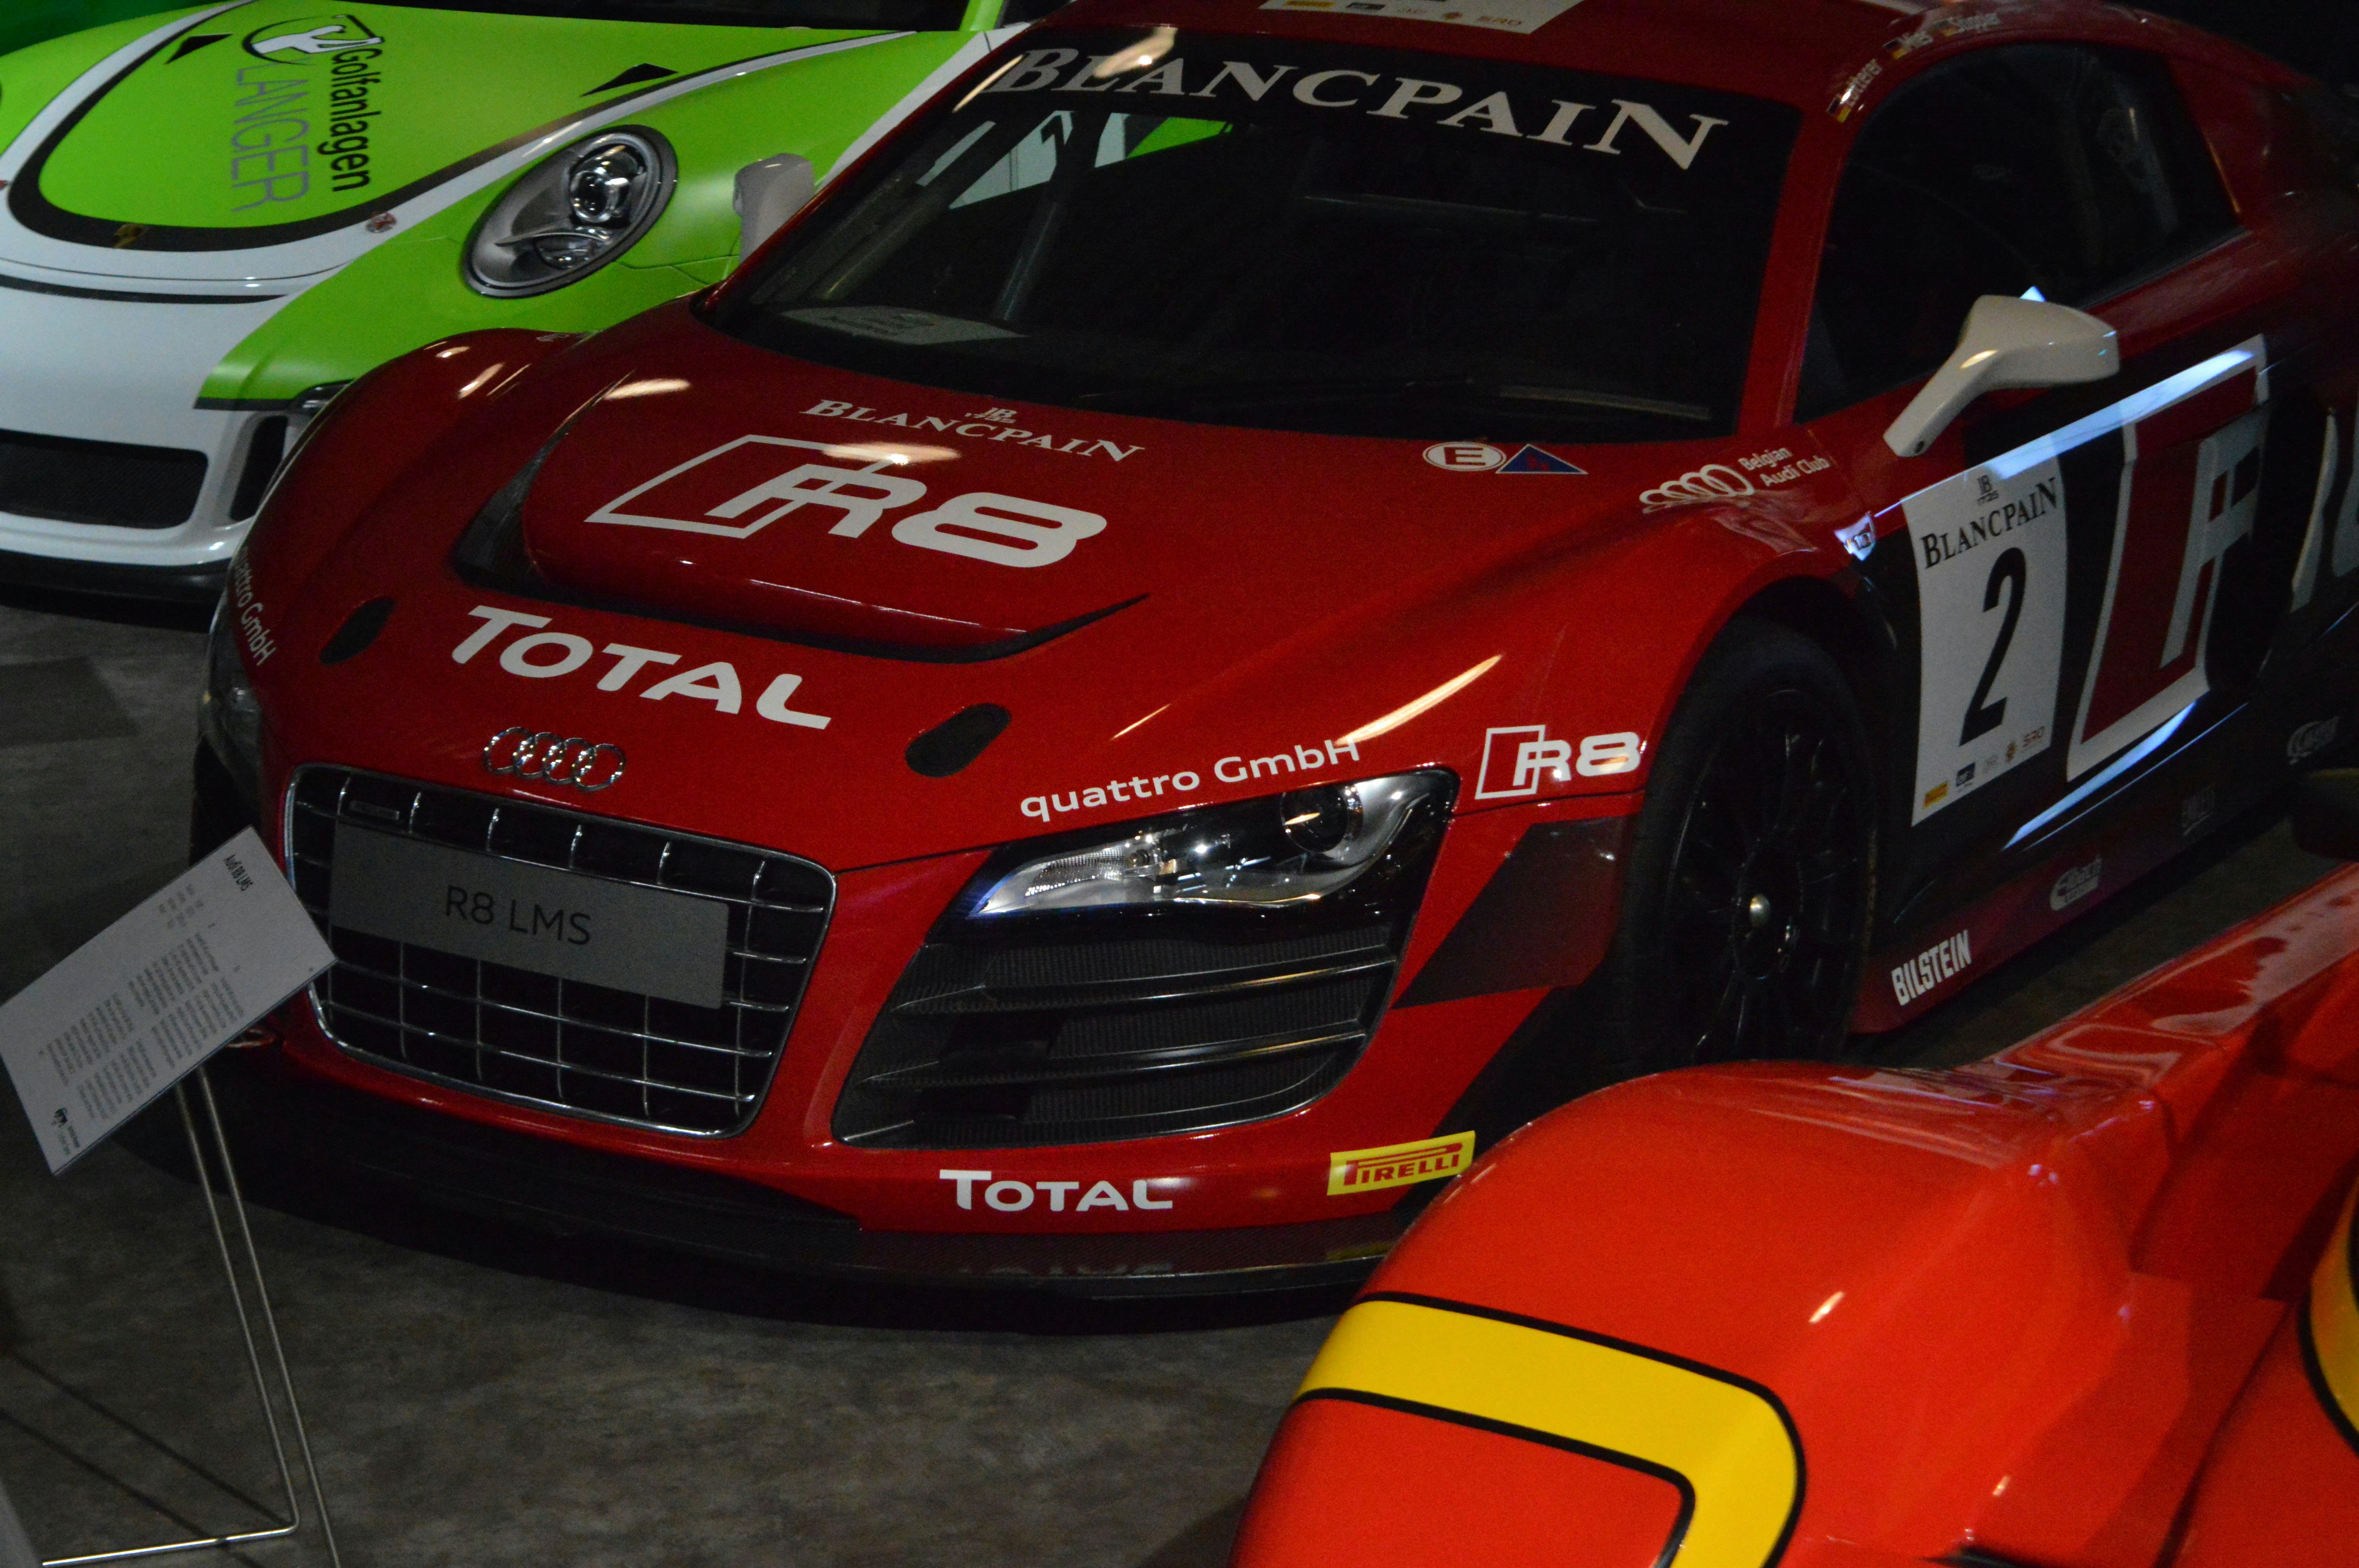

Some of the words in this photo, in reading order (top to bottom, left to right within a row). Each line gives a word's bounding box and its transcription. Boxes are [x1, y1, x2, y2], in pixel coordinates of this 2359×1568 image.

[231, 57, 309, 212] LANGER
[317, 48, 383, 192] Golfanlagen
[982, 47, 1729, 171] BLANCPAIN
[799, 399, 1146, 462] BLANCPAIN
[1737, 447, 1793, 471] Belgian
[1759, 464, 1801, 487] Audi
[1796, 455, 1831, 474] Club
[704, 457, 1107, 568] R8
[1921, 477, 2057, 569] BLANCPAIN
[234, 546, 253, 608] uattro
[240, 603, 277, 666] GmbH
[1959, 547, 2026, 746] 2
[451, 605, 832, 730] TOTAL
[1020, 767, 1200, 822] quattro
[1214, 739, 1361, 783] GmbH
[1512, 731, 1641, 786] R8
[224, 853, 242, 870] Audi
[231, 866, 245, 879] R8
[236, 873, 253, 892] LMS
[445, 886, 493, 925] R8
[509, 903, 592, 945] LMS
[1891, 929, 1973, 1006] BILSTEIN
[939, 1169, 1173, 1212] TOTAL
[1343, 1142, 1463, 1186] PIRELLI
